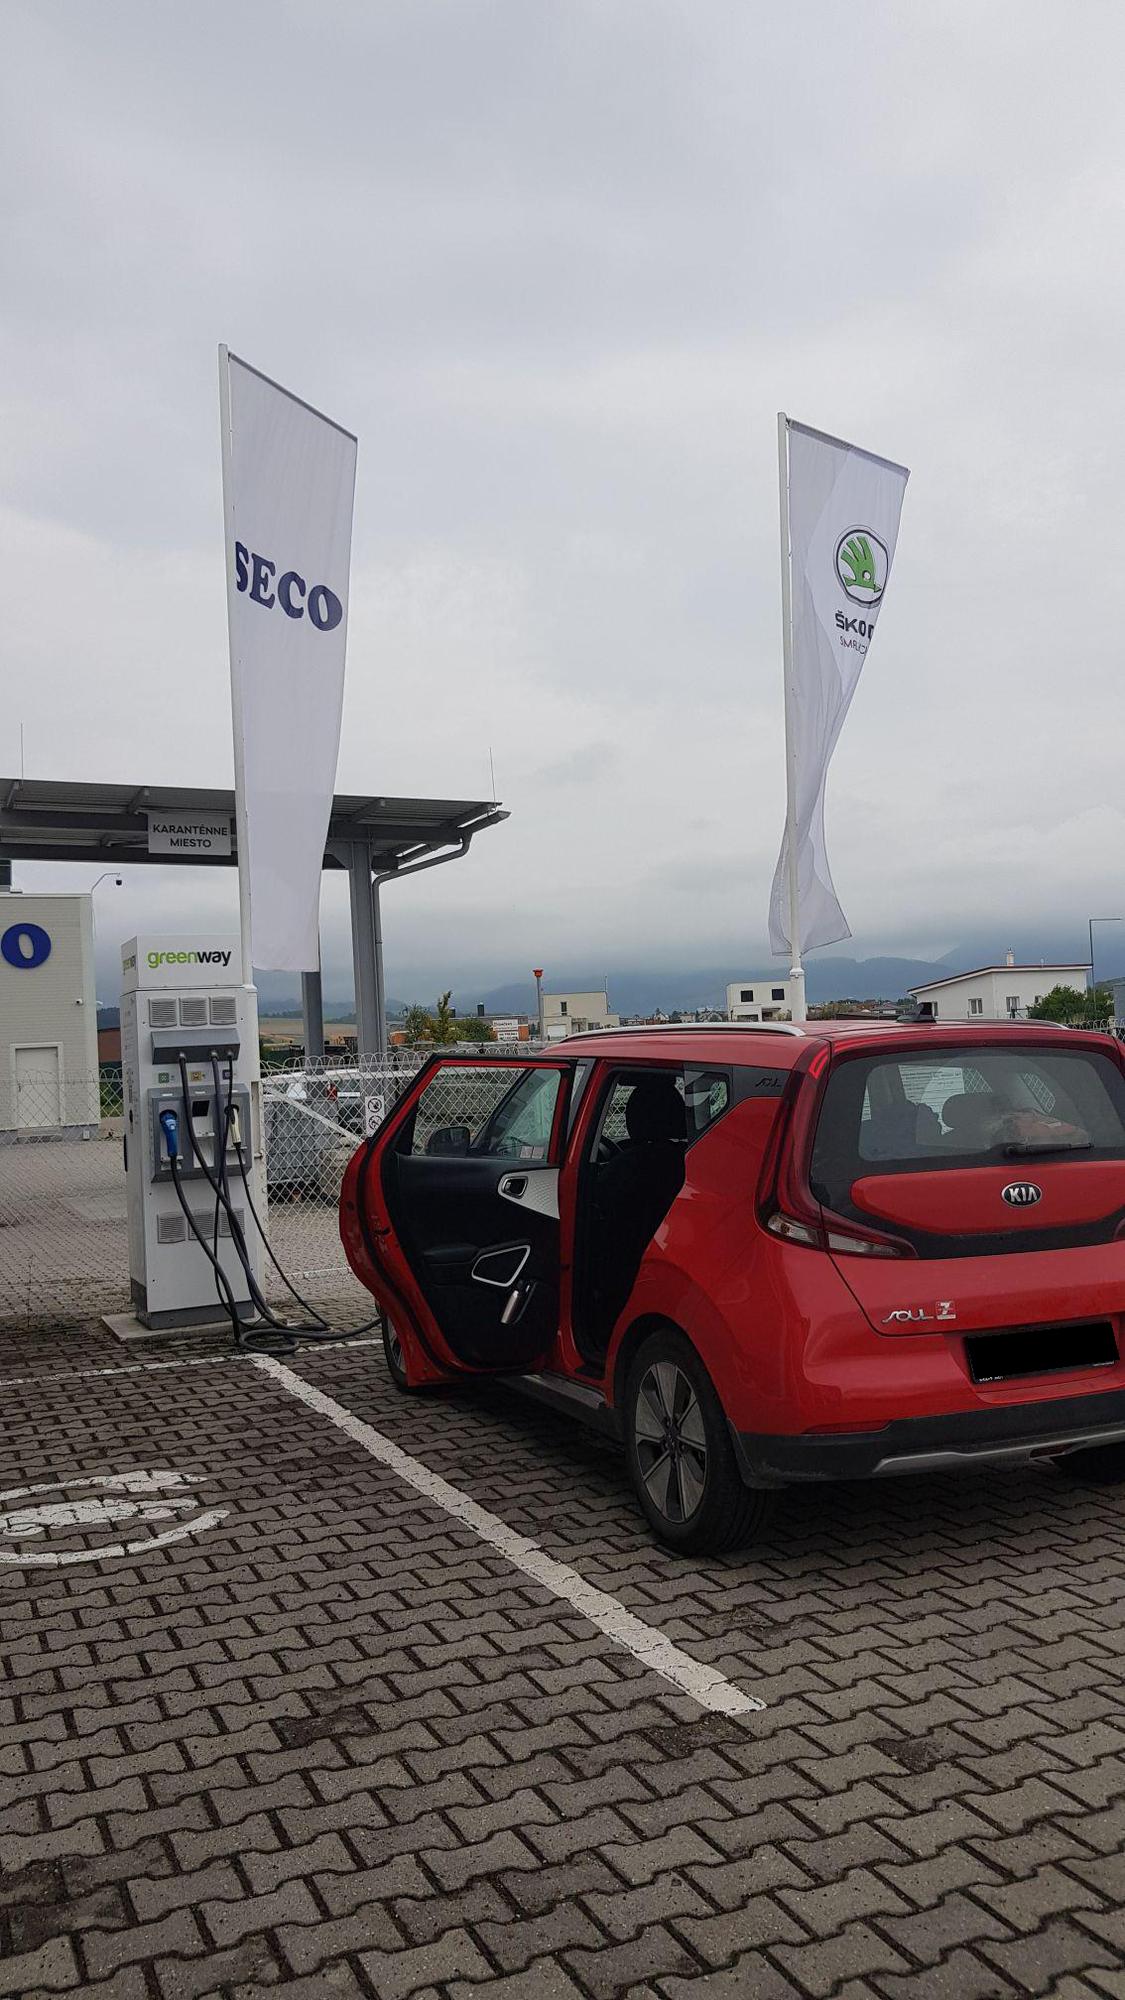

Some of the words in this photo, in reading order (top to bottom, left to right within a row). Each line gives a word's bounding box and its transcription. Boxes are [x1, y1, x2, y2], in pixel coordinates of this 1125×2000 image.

[235, 541, 343, 631] SECO
[153, 823, 228, 836] KARANTÉNNE
[170, 838, 212, 848] MIESTO
[147, 951, 232, 969] greenway
[1008, 1186, 1038, 1202] KIA
